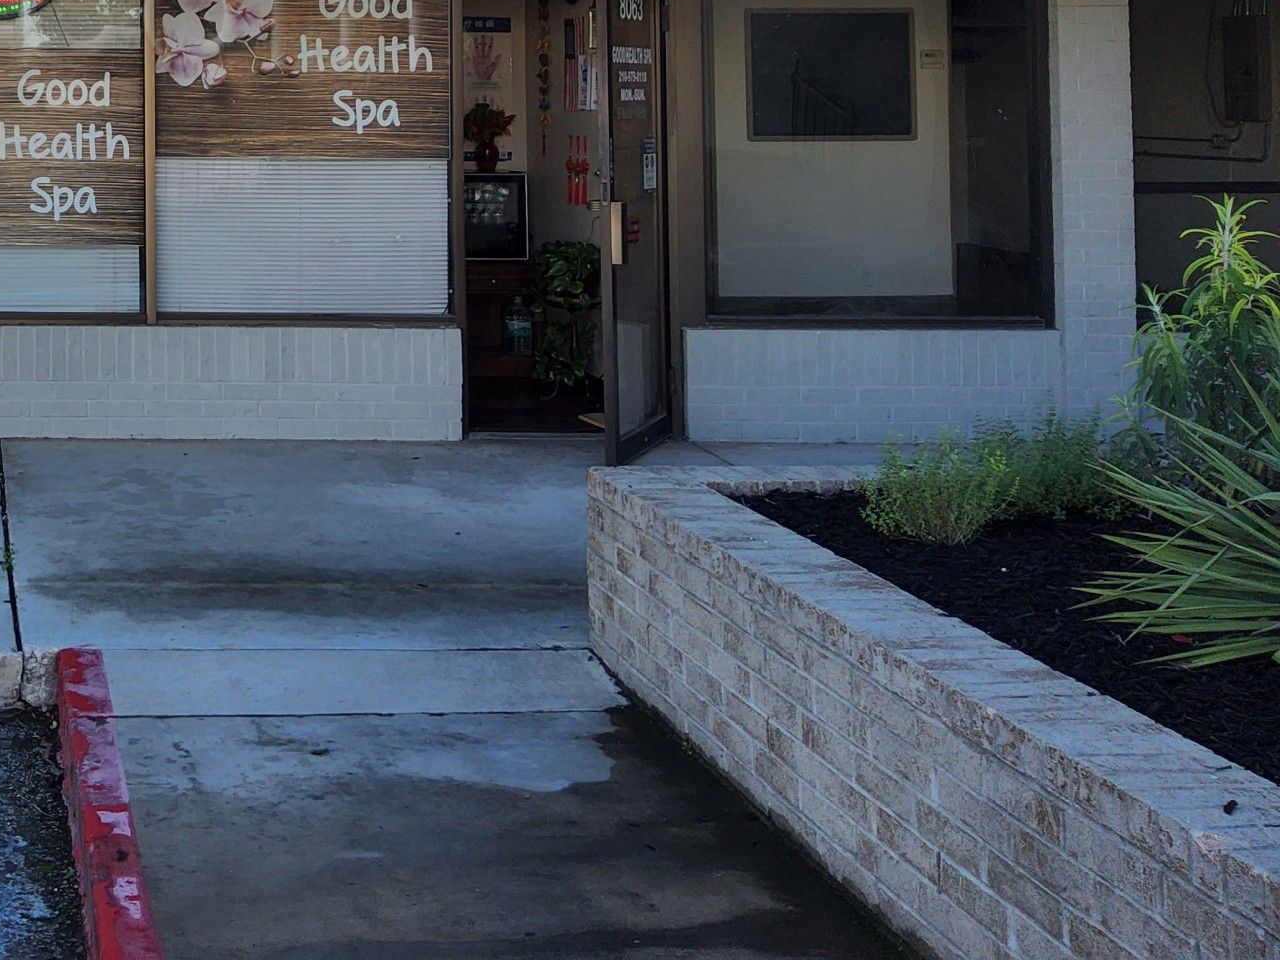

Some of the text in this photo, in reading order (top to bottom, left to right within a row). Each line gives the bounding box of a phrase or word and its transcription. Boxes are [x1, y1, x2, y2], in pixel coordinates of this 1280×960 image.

[297, 35, 433, 75] Health
[17, 69, 112, 108] Good
[332, 90, 401, 135] Spa
[30, 177, 98, 222] Spa
